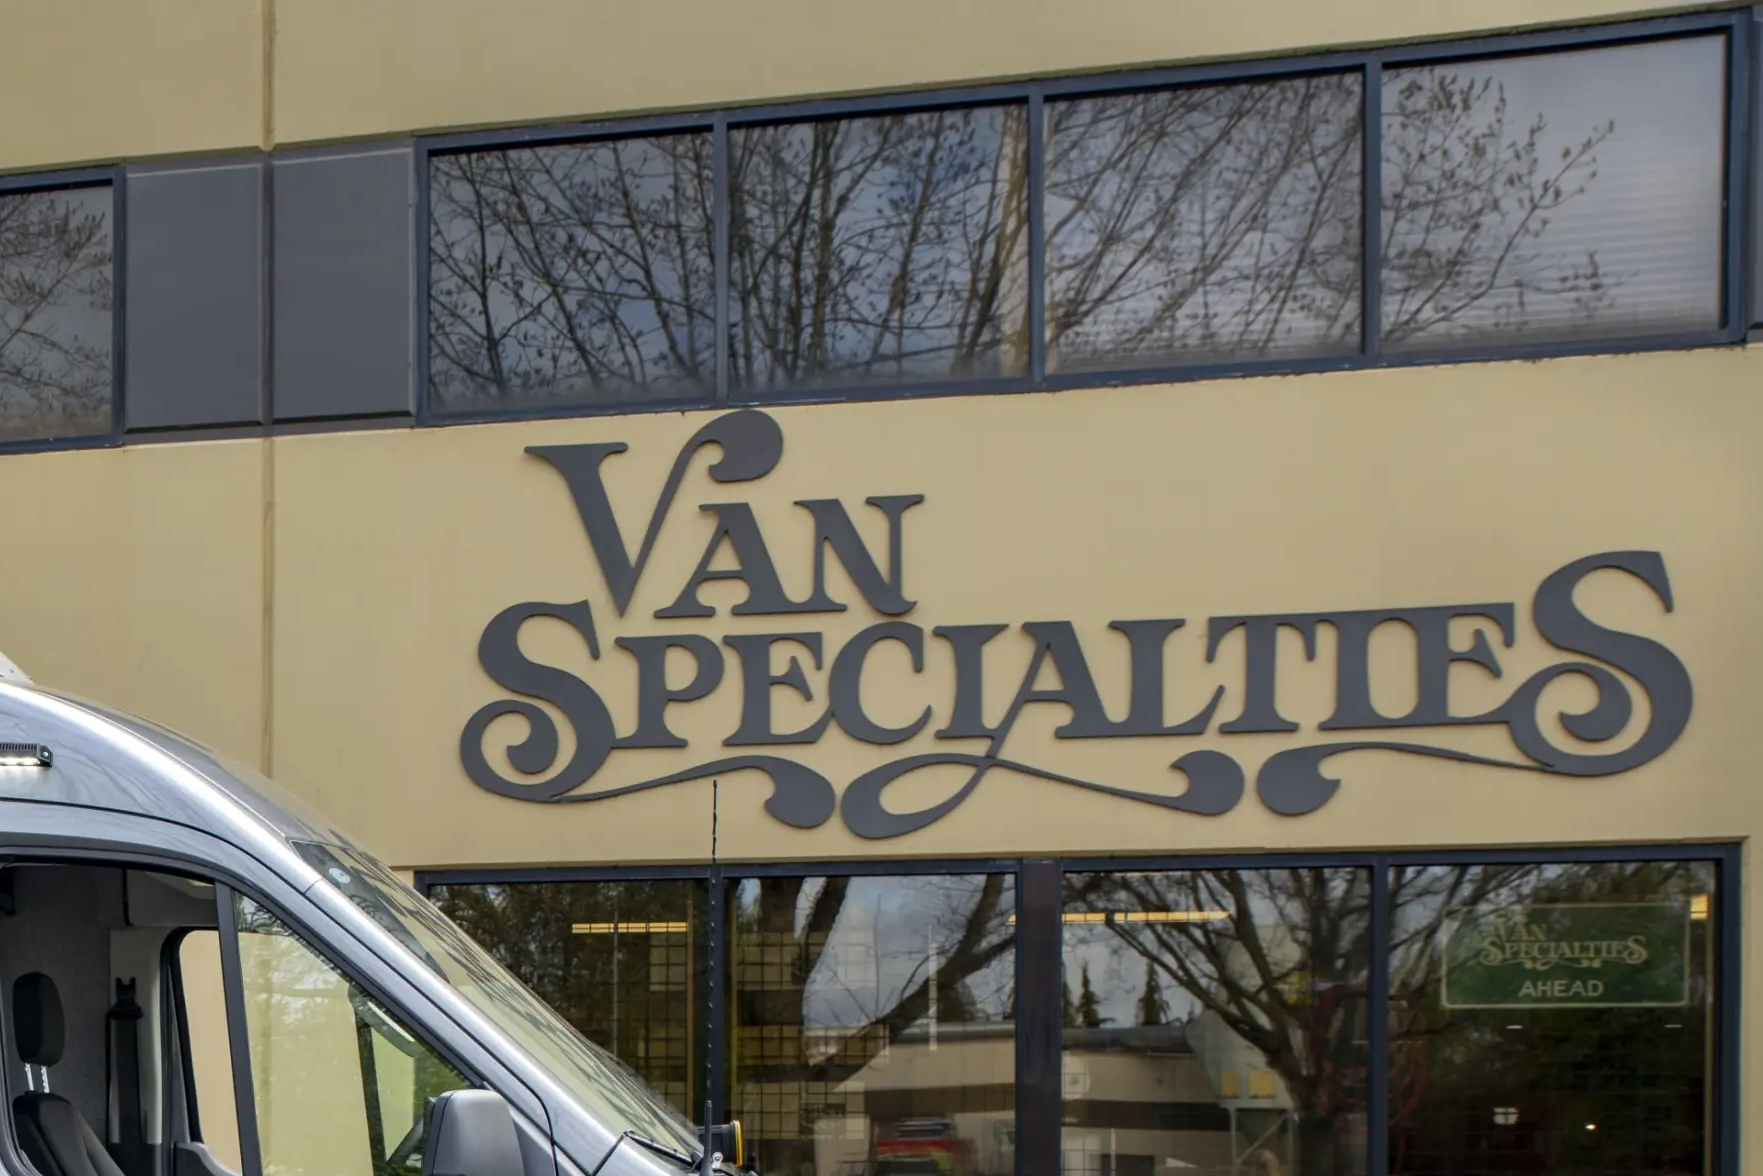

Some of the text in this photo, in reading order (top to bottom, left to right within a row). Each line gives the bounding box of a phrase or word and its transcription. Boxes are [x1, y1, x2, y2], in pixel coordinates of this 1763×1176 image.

[524, 408, 924, 618] VAN
[459, 550, 1694, 840] SPECIALTIES
[1493, 914, 1548, 942] VAN
[1479, 935, 1649, 971] SPECIALTIES
[1518, 979, 1605, 998] AHEAD
